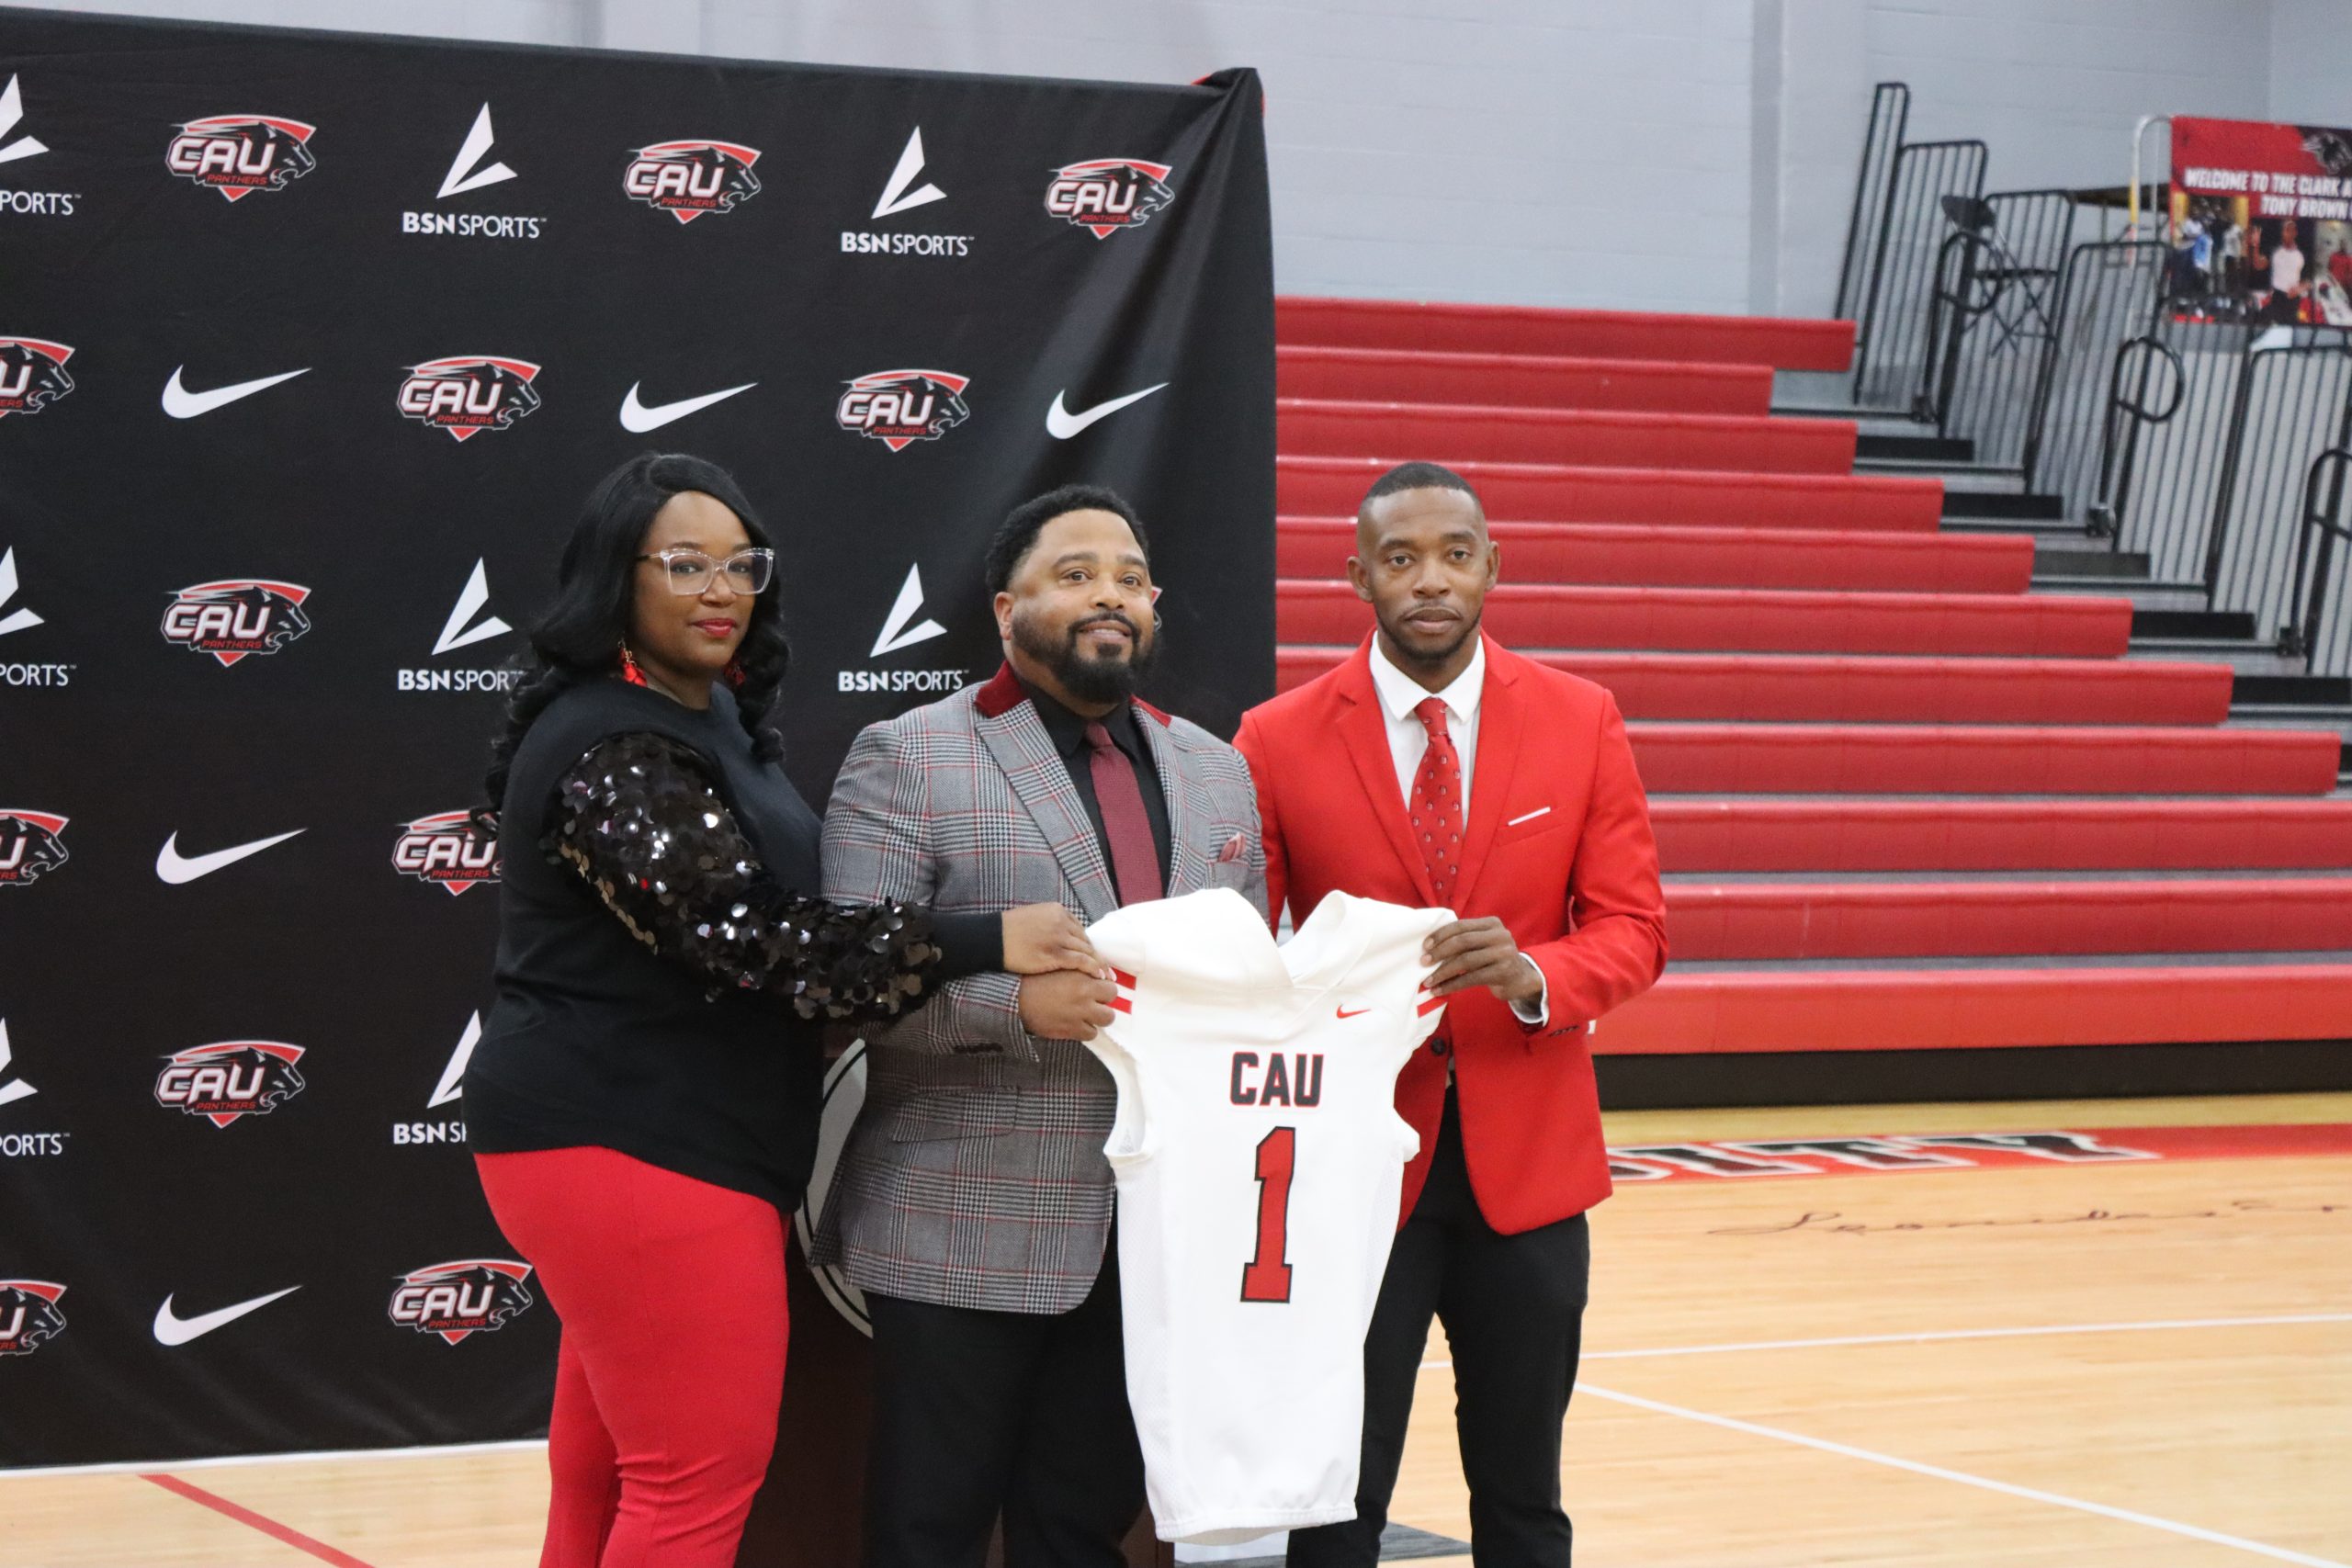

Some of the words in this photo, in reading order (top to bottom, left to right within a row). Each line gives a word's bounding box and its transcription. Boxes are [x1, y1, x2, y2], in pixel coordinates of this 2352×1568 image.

[169, 137, 276, 175] CAU
[206, 174, 267, 185] PANTHERS
[627, 162, 725, 199] CAU
[2186, 169, 2249, 190] WELCOME
[2251, 173, 2268, 192] TO
[2272, 174, 2295, 193] THE
[2299, 176, 2340, 196] CLARK
[661, 197, 717, 208] PANTHERS
[1048, 179, 1137, 216] CAU
[2261, 196, 2297, 215] TONY
[2299, 198, 2348, 219] BROWN
[1080, 214, 1130, 222] PANTHERS
[400, 378, 503, 417] CAU
[840, 390, 933, 429] CAU
[436, 415, 494, 425] PANTHERS
[874, 426, 926, 435] PANTHERS
[164, 602, 271, 641] CAU
[201, 639, 263, 649] PANTHERS
[432, 870, 490, 878] PANTHERS
[158, 1063, 265, 1104] CAU
[1230, 1051, 1325, 1108] CAU
[196, 1102, 257, 1111] PANTHERS
[1239, 1125, 1296, 1303] 1
[391, 1281, 495, 1324] CAU
[428, 1318, 486, 1328] PANTHERS
